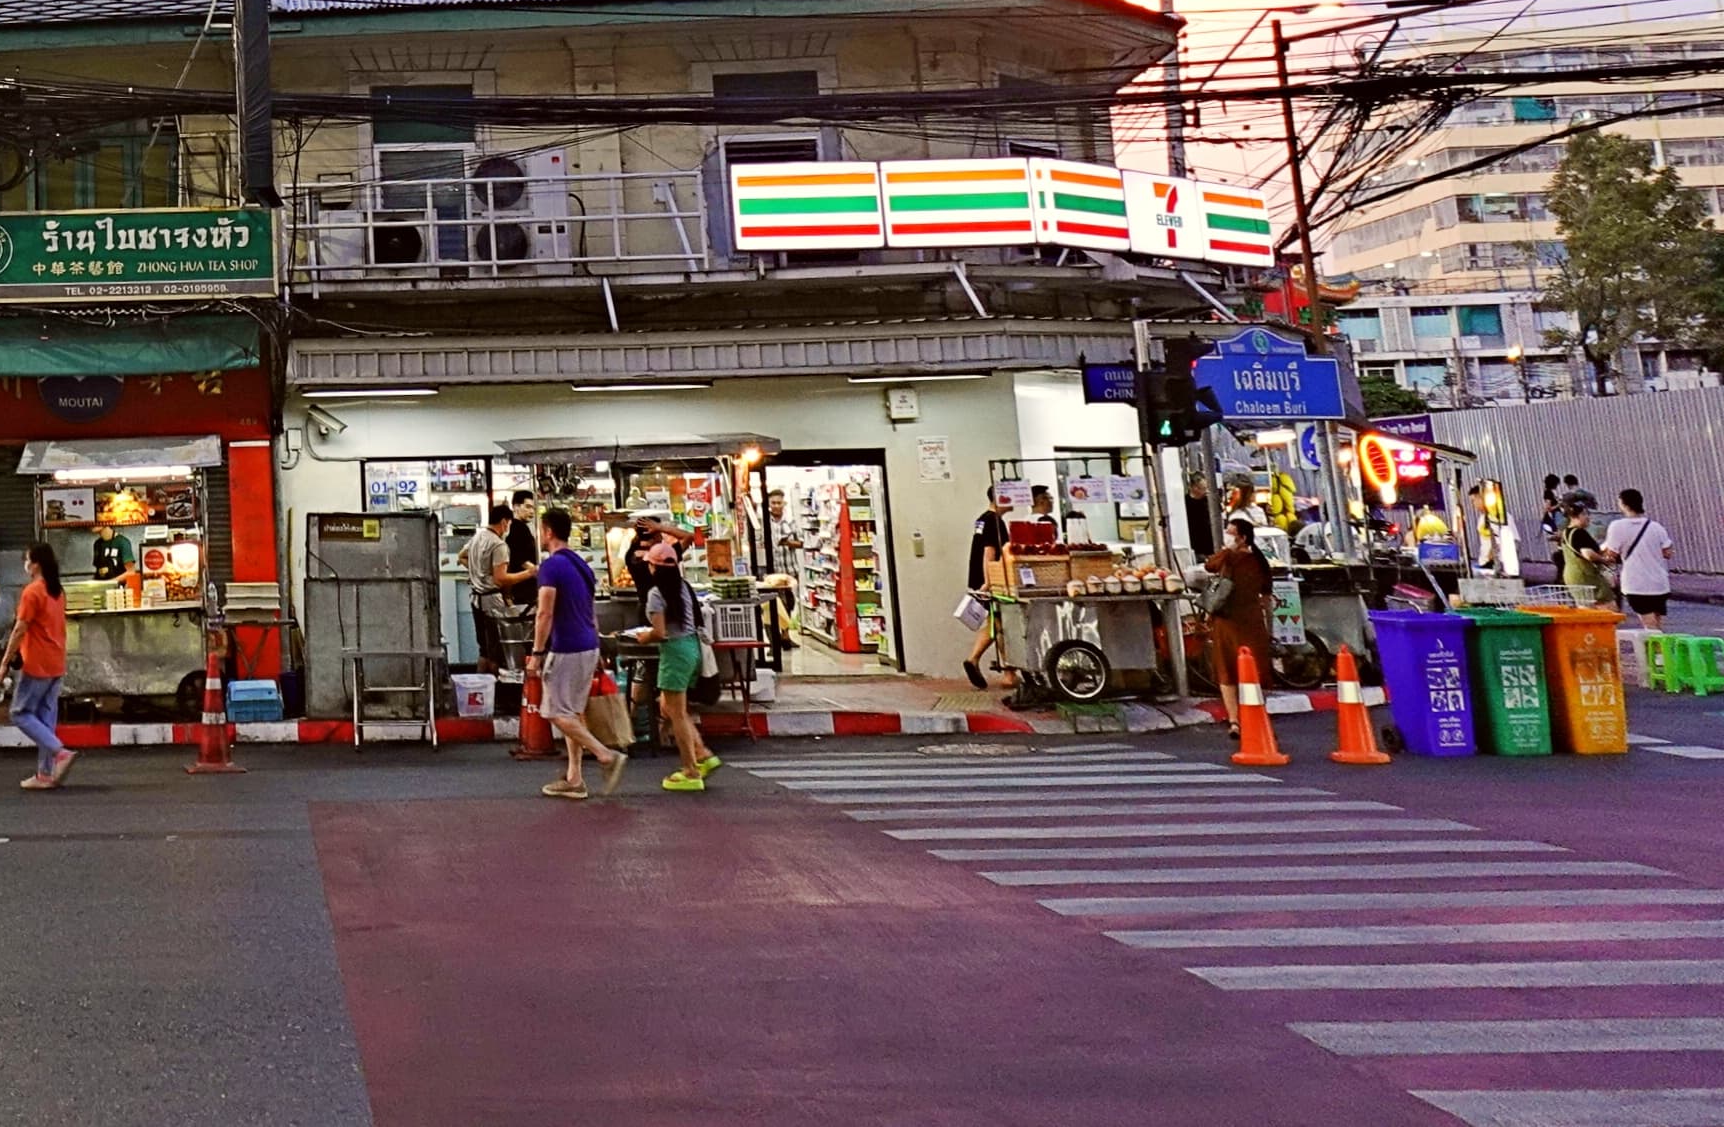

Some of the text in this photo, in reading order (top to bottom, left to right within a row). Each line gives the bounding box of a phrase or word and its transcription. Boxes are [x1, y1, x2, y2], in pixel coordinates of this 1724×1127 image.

[137, 259, 259, 274] ZHONG HUA TEA SHOP
[1233, 361, 1301, 400] เฉลิมบุรี
[1104, 388, 1137, 400] CHIN
[58, 396, 104, 409] MOUTAI
[1235, 400, 1308, 414] Chaloem Buri
